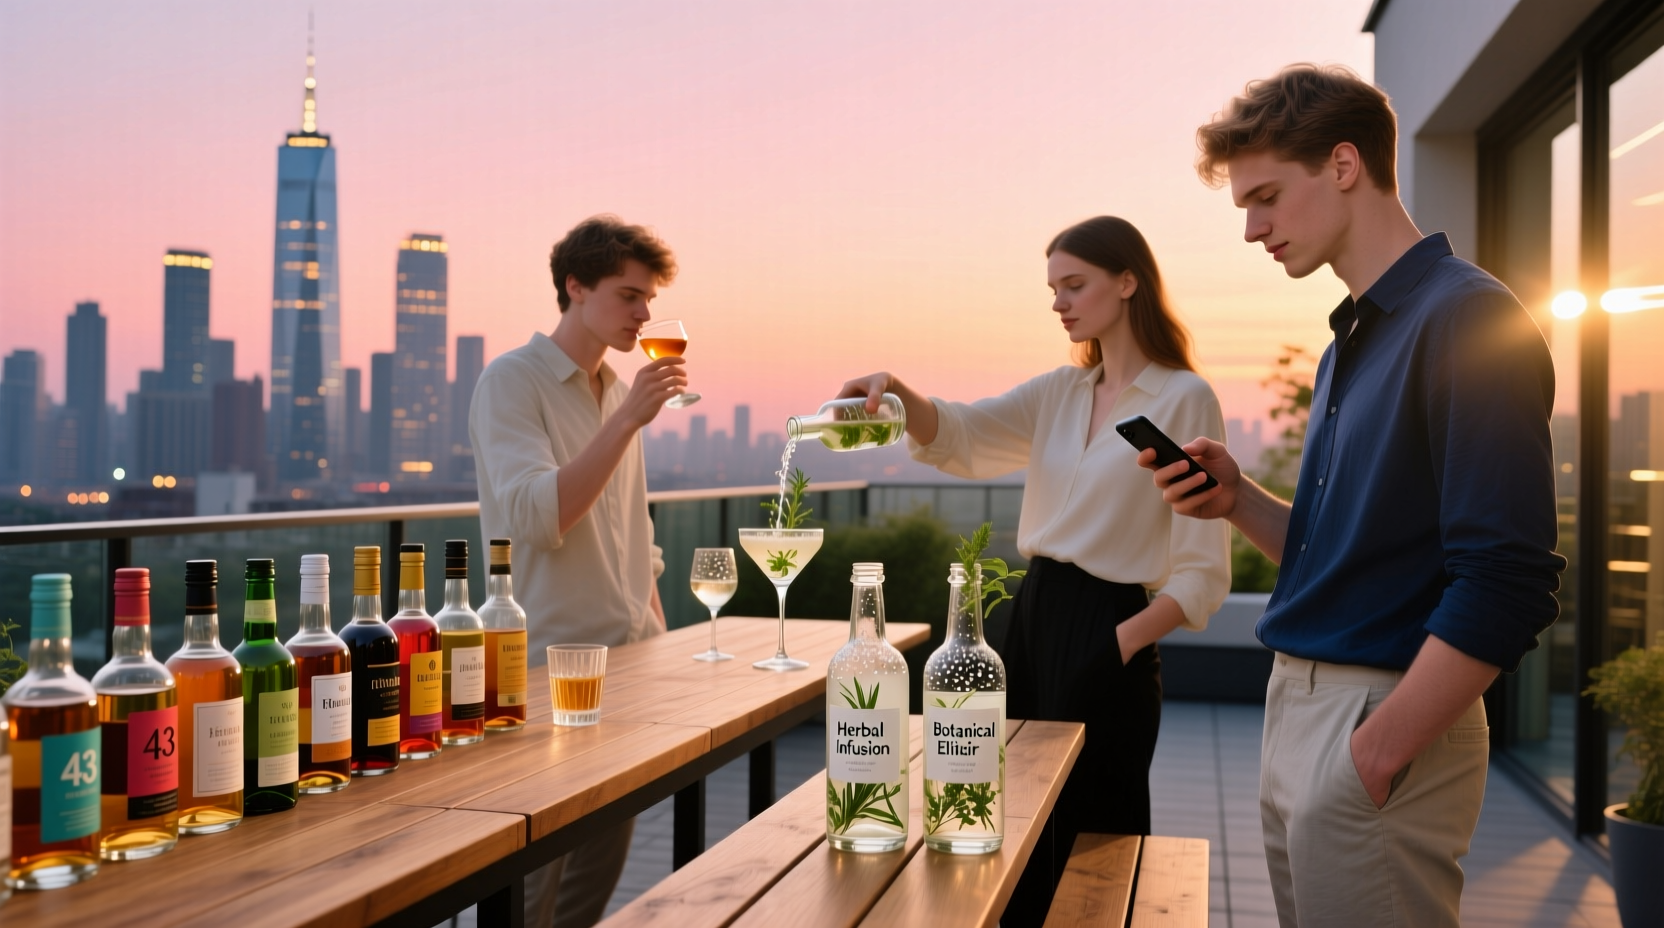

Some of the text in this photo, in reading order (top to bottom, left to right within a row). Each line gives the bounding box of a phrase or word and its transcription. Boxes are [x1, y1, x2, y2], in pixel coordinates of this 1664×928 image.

[837, 721, 884, 738] Herbal
[933, 721, 995, 738] Botanical
[143, 726, 175, 760] 43
[836, 739, 890, 756] Infusion
[60, 749, 97, 786] 43
